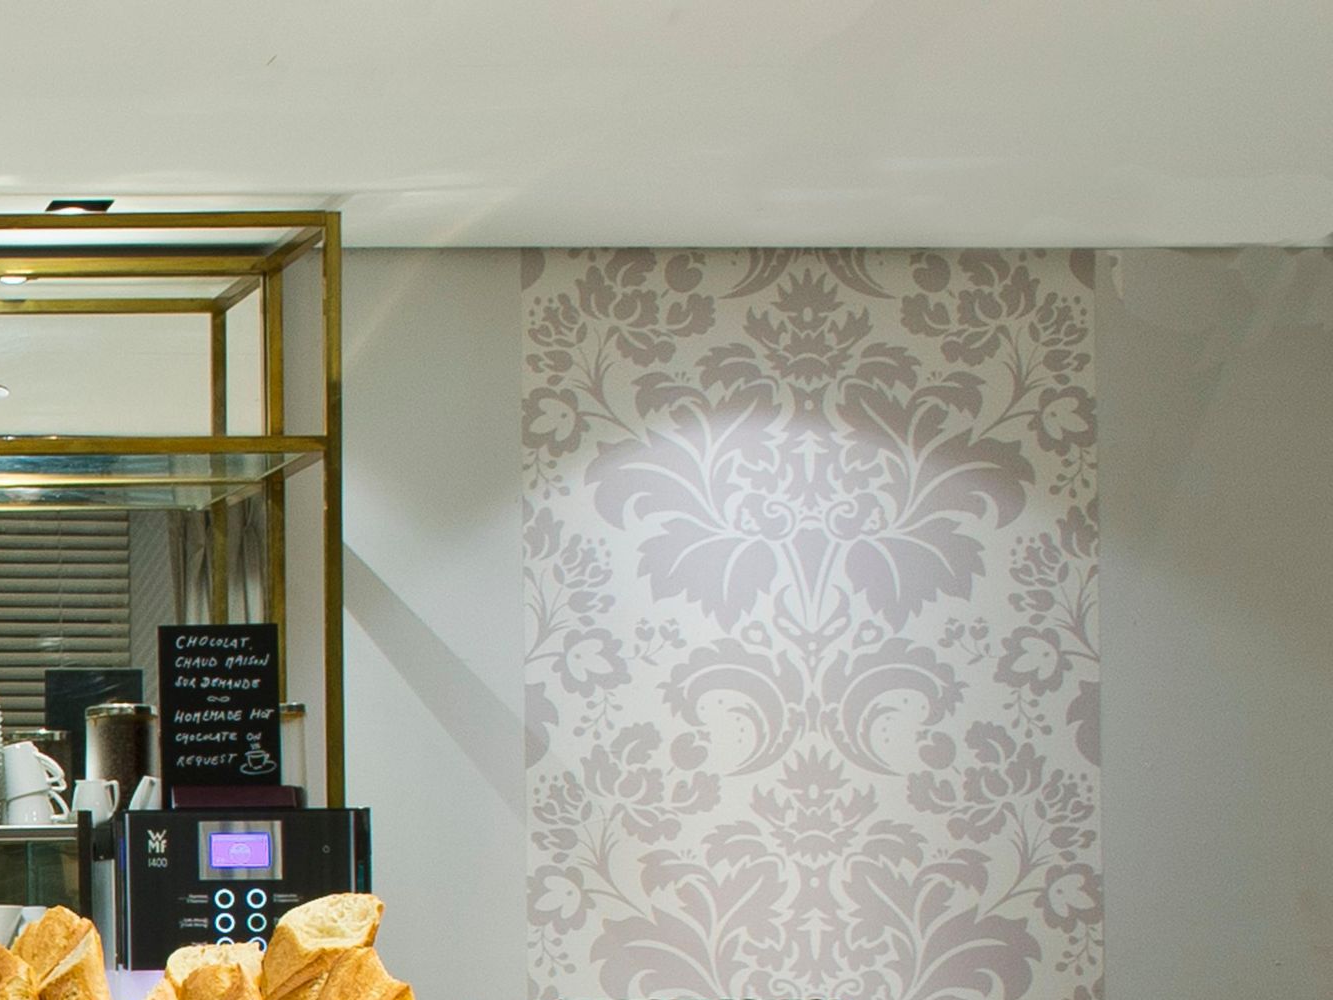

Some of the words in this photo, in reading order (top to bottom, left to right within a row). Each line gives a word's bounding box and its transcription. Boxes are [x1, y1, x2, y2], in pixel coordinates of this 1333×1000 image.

[175, 656, 218, 669] CHAUD
[225, 653, 270, 669] MAISON
[175, 676, 197, 688] SUR
[200, 676, 261, 689] DEMANDE
[174, 709, 243, 724] HOMEMADE
[176, 753, 238, 767] REQUEST
